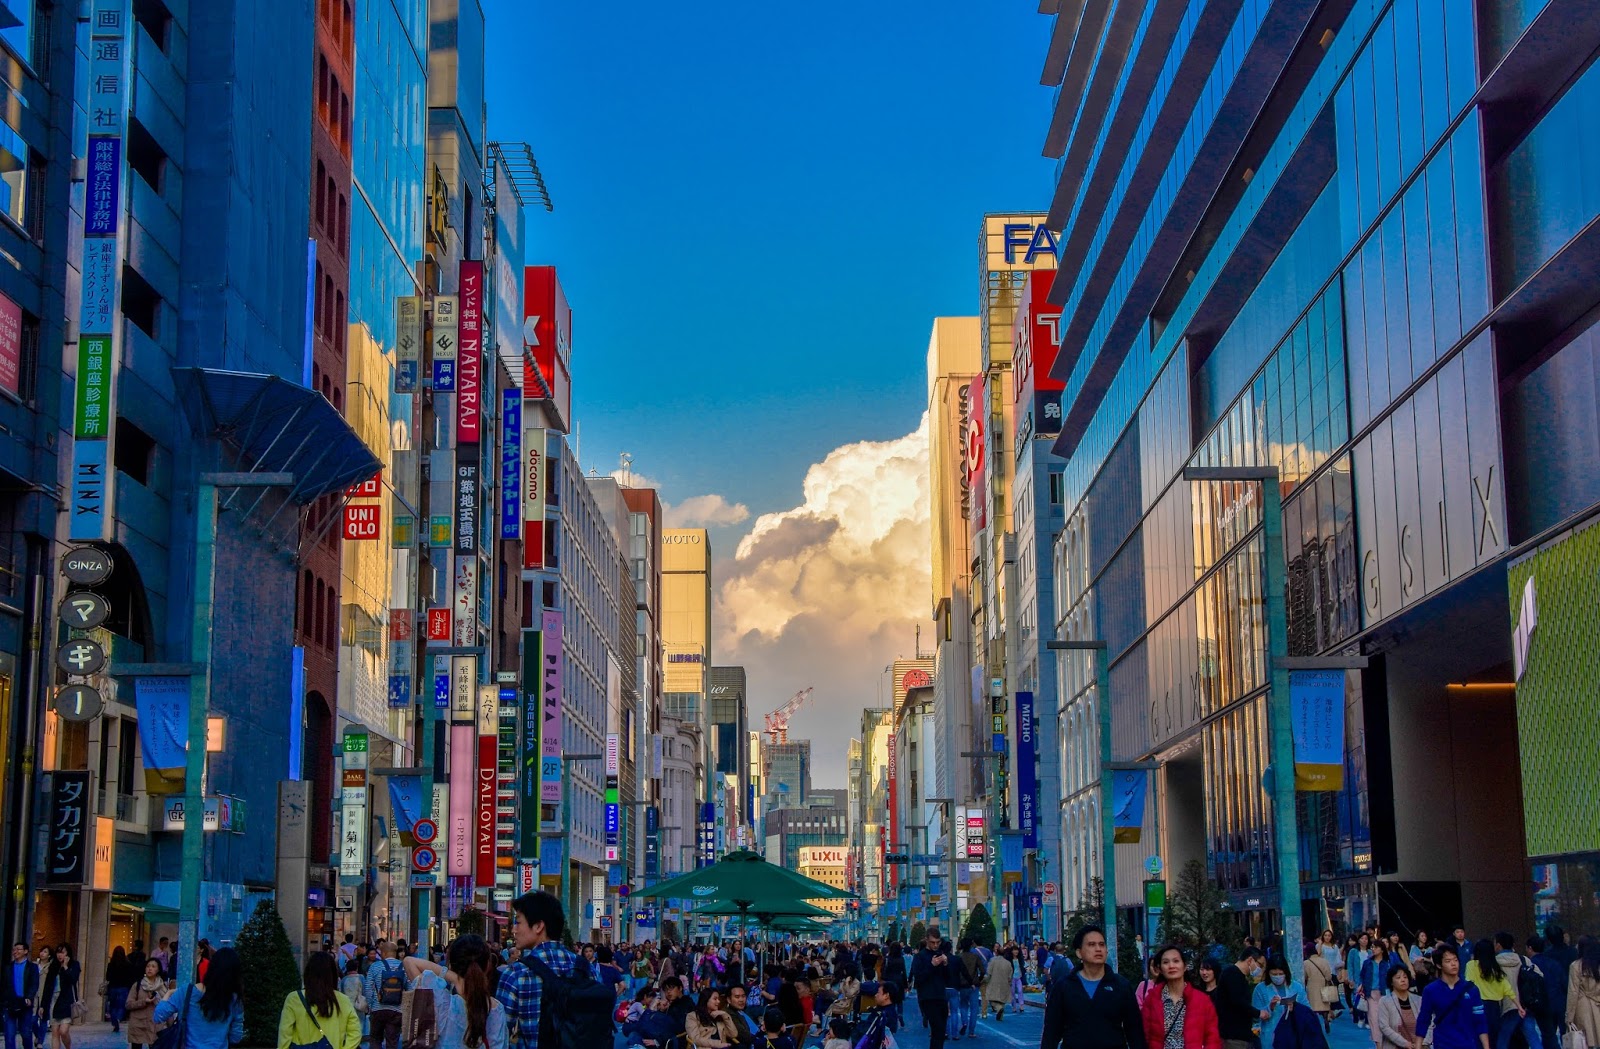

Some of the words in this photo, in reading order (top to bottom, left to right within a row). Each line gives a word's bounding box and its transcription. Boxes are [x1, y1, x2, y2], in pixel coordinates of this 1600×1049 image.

[93, 9, 121, 128] 画通信社
[91, 141, 114, 231] 銀座総合法律事務所
[85, 243, 98, 330] レディスクリニック
[98, 243, 112, 325] 銀座すずらん通り
[463, 275, 478, 331] インド料理
[84, 340, 104, 434] 西銀座診療所
[460, 339, 478, 430] NATARAJ
[77, 463, 101, 516] MINX
[459, 466, 476, 476] 6F
[529, 449, 541, 500] docomo
[348, 508, 374, 521] UNI
[348, 522, 376, 537] QLO
[504, 524, 518, 533] 6F
[68, 560, 103, 571] GINZA
[545, 654, 557, 723] PLAZA
[1022, 703, 1031, 743] MIZUHO
[543, 763, 557, 775] 2F
[53, 781, 84, 874] タカゲン
[418, 825, 433, 837] 50
[480, 768, 495, 855] DALLOYAU
[957, 815, 965, 849] GINZA
[345, 830, 357, 859] 菊水
[456, 817, 465, 868] I-PRIMO
[812, 851, 843, 862] LIXIL
